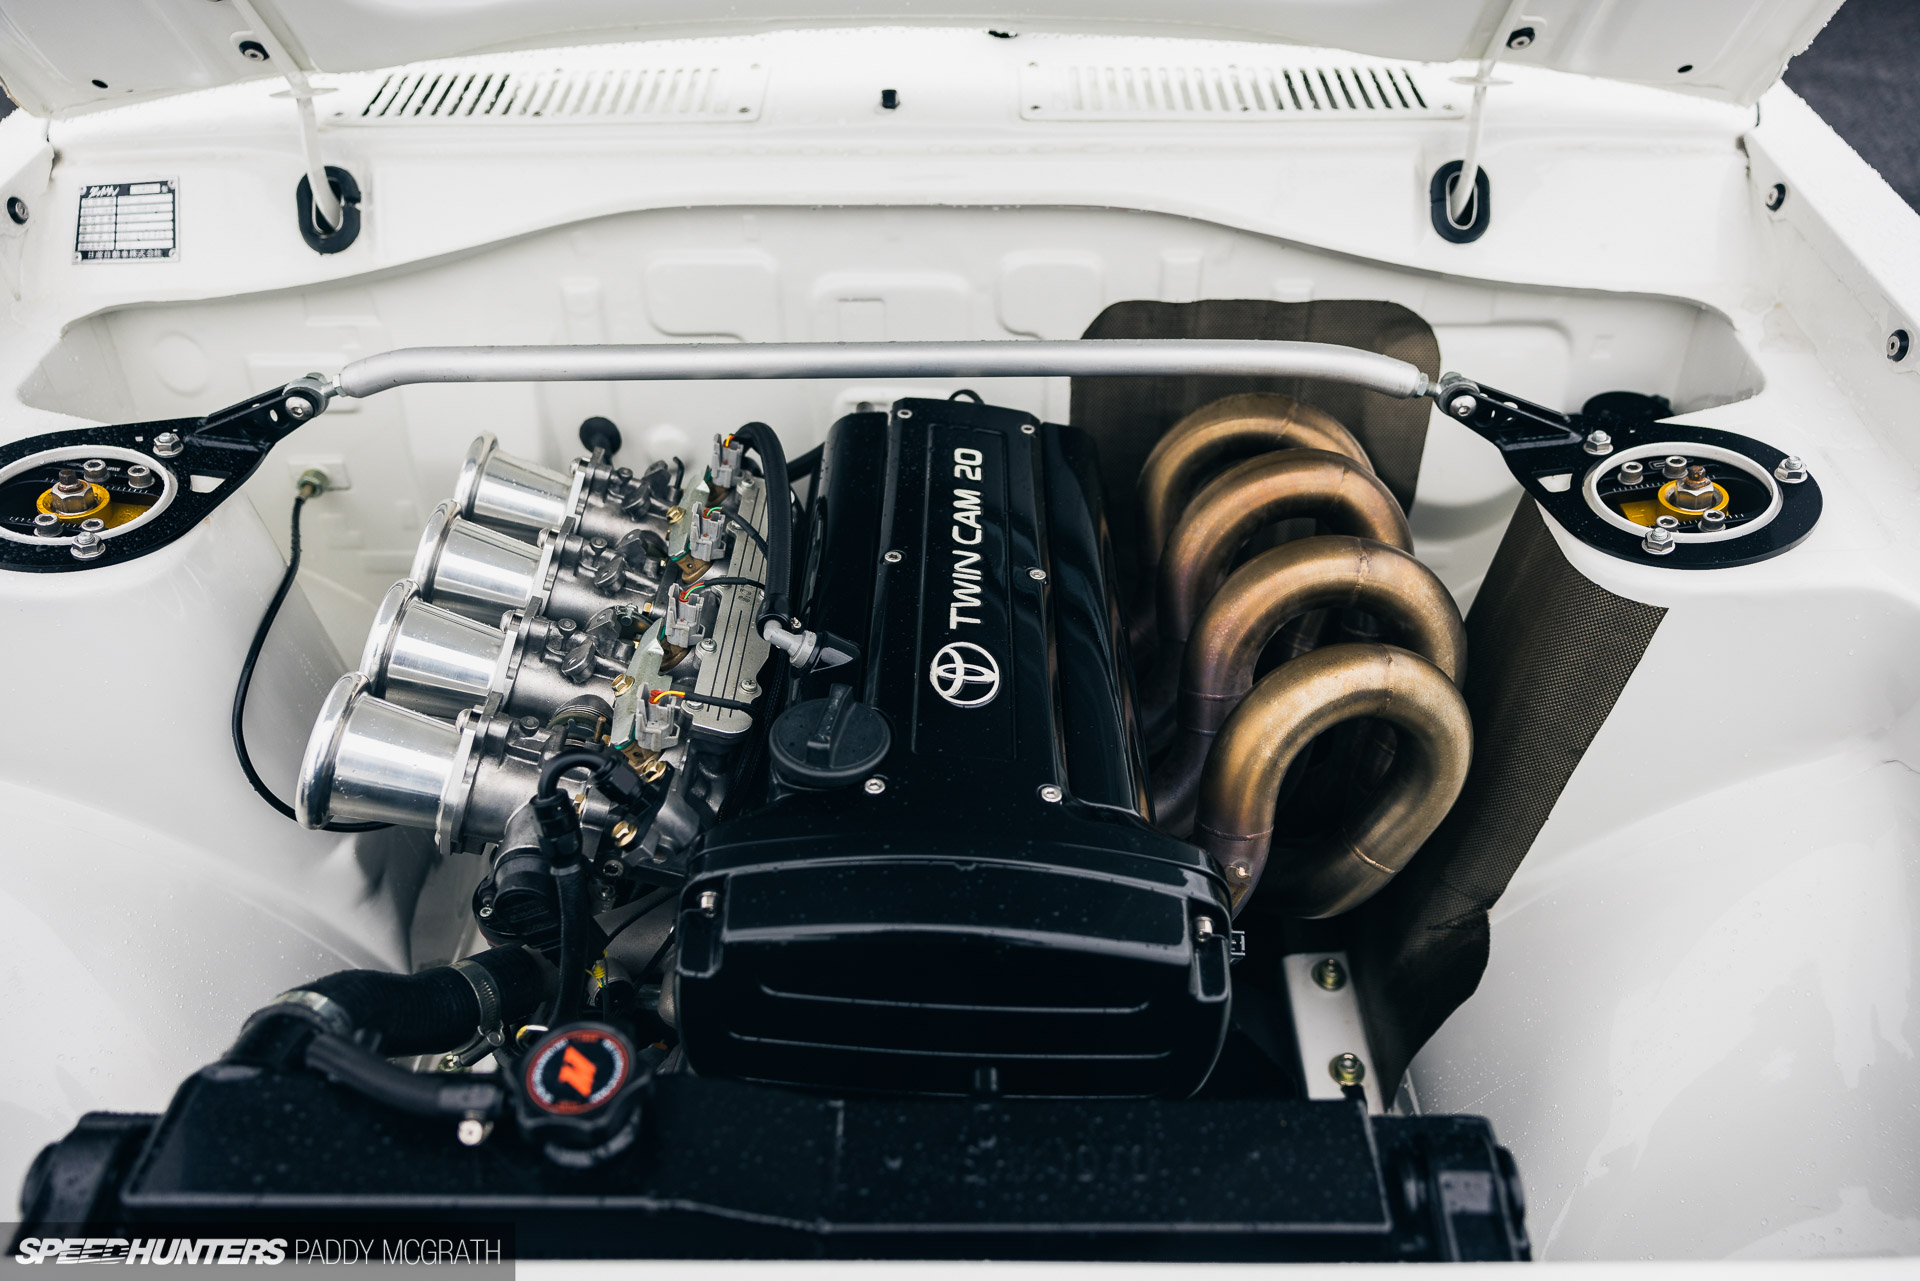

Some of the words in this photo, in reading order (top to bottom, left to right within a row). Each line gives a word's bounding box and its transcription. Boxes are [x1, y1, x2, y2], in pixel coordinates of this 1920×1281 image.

[953, 447, 983, 482] 20
[952, 488, 983, 545] CAM
[949, 549, 982, 630] TWIN
